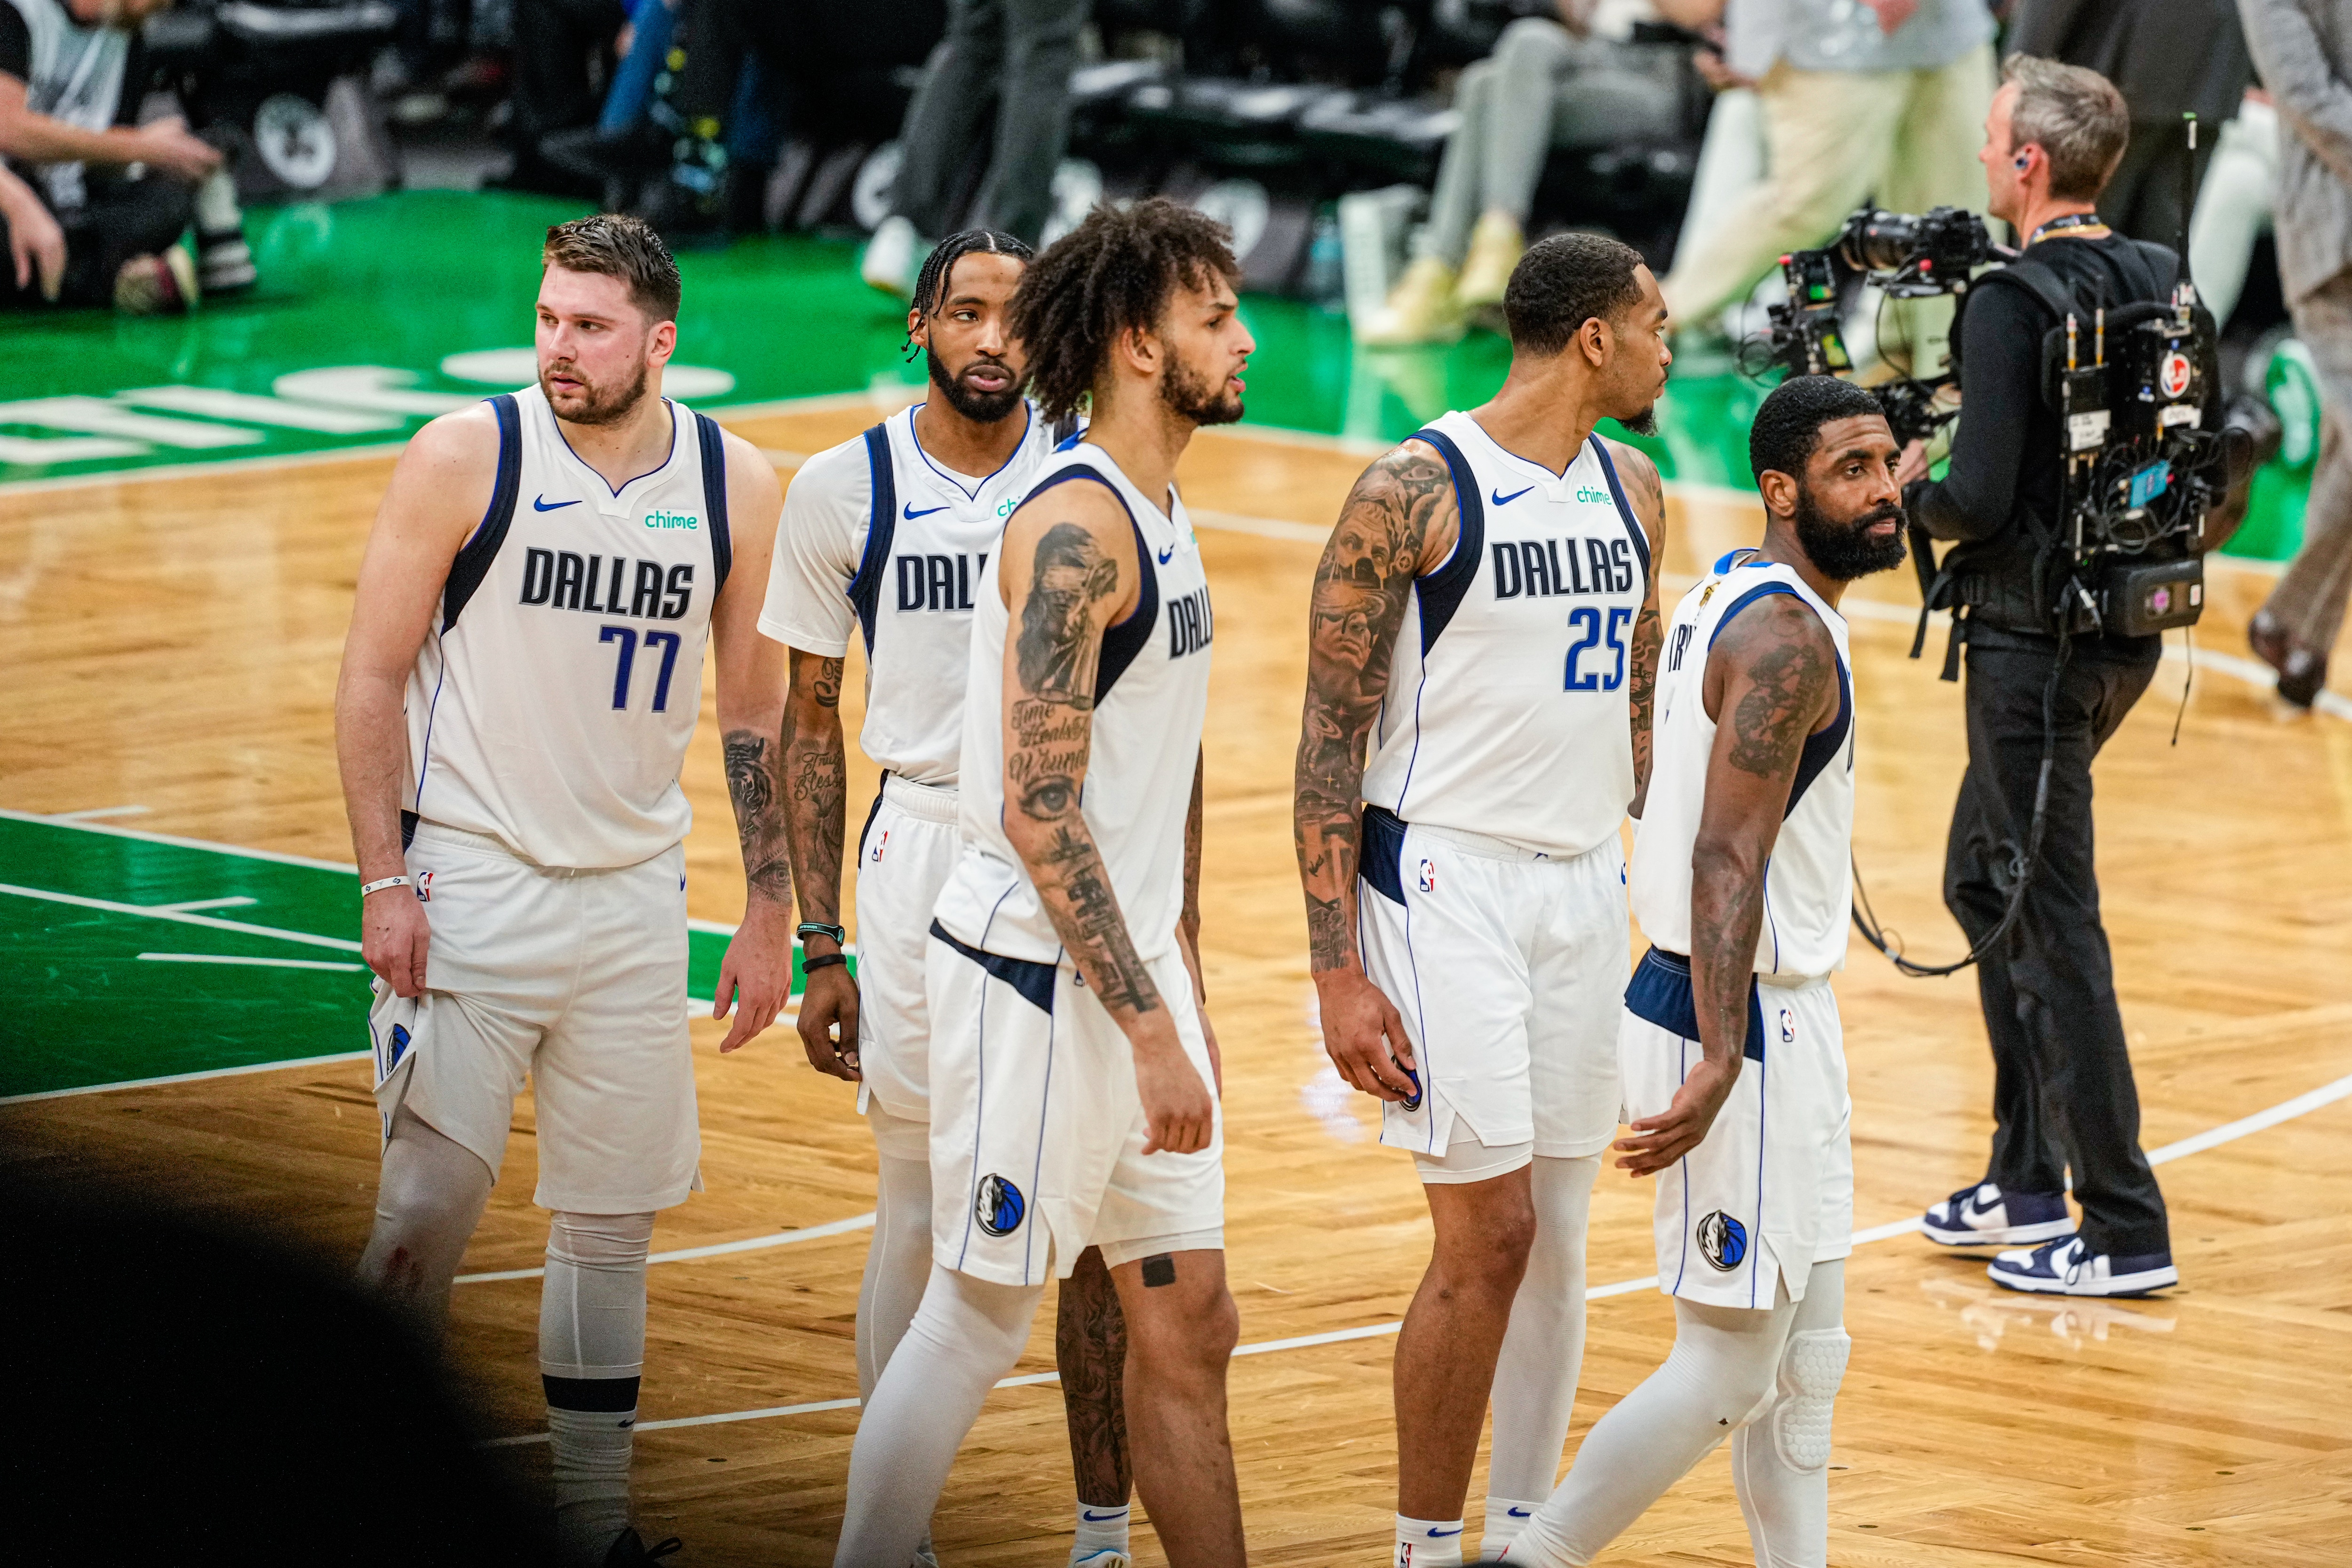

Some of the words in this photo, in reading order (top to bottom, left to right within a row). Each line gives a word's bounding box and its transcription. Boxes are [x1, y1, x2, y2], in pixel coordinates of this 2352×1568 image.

[645, 510, 697, 530] chime
[997, 496, 1021, 517] ch
[1577, 486, 1612, 505] chime
[519, 546, 695, 620] DALLAS
[1490, 537, 1633, 601] DALLAS
[1166, 585, 1213, 660] DALL
[1563, 606, 1633, 692] 25
[598, 624, 681, 713] 77
